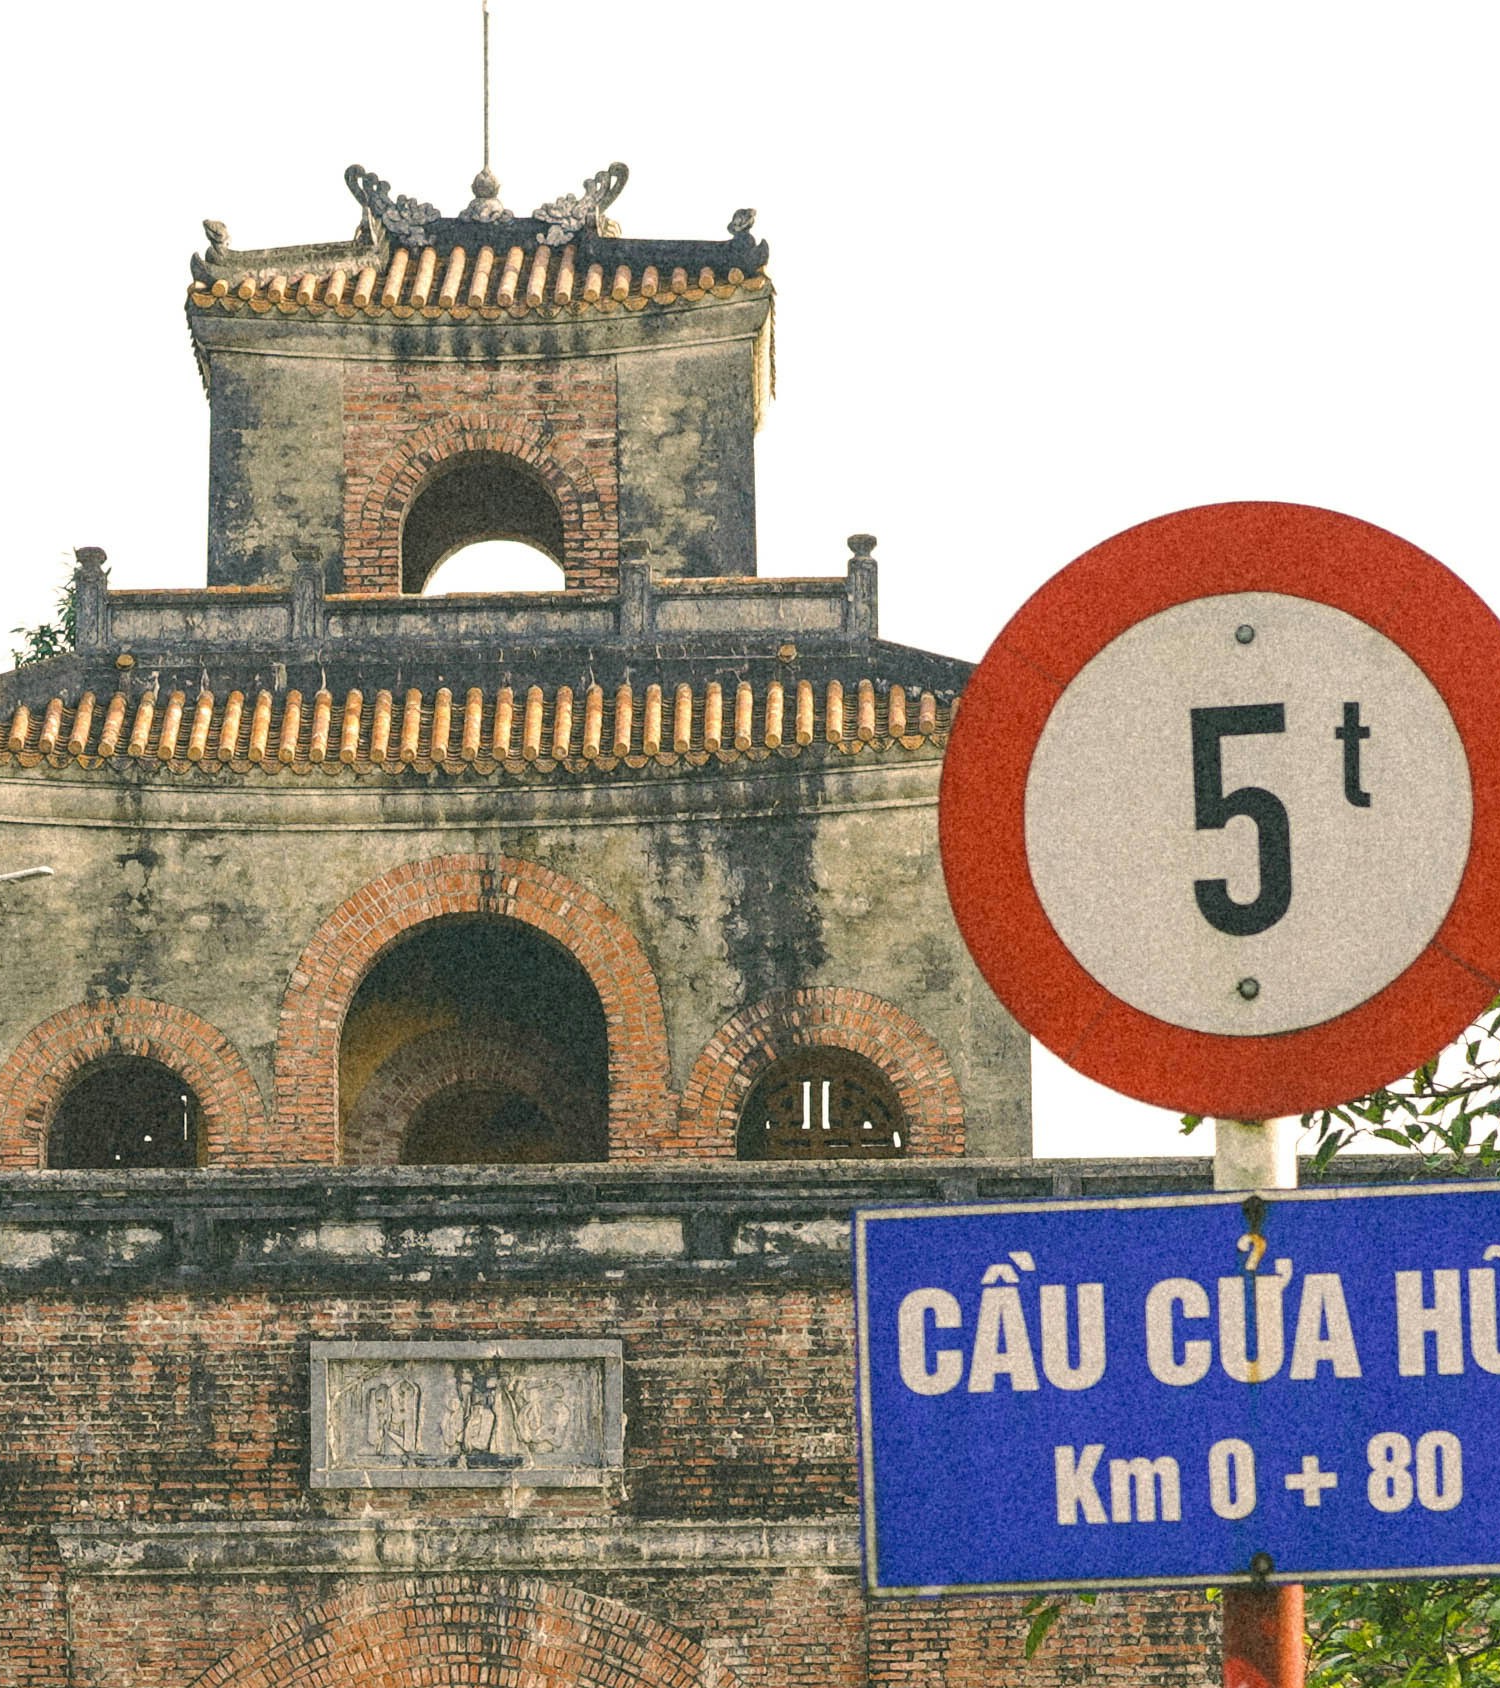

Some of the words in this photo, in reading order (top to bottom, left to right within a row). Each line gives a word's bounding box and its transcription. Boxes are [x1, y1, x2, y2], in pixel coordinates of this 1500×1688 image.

[897, 1250, 1107, 1396] CẦU
[1145, 1234, 1363, 1384] CỬA
[1054, 1443, 1182, 1527] Km
[1208, 1437, 1257, 1521] 0
[1284, 1454, 1338, 1508] +
[1365, 1430, 1464, 1514] 80
